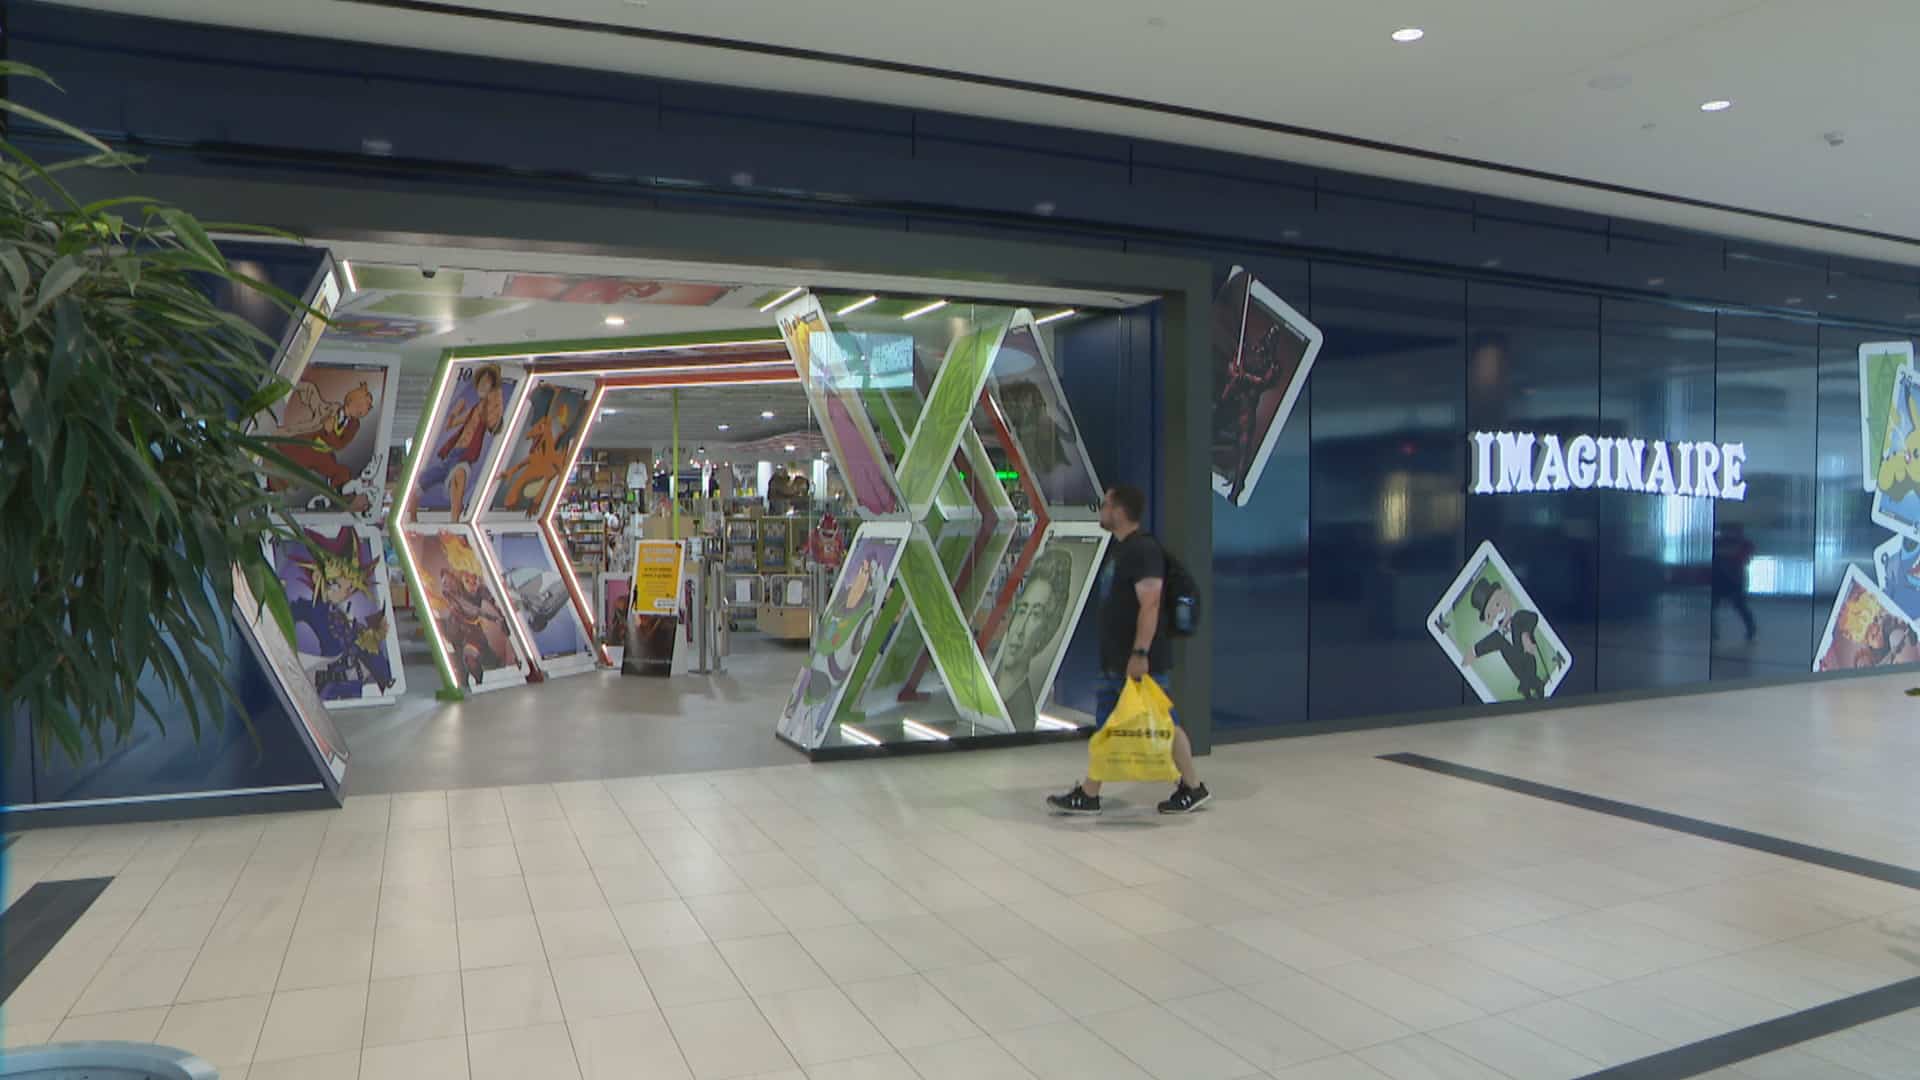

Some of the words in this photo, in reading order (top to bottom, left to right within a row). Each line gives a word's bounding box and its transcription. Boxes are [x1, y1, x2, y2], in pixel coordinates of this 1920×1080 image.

[458, 367, 473, 382] 10
[1473, 430, 1747, 501] IMAGINAIRE
[1434, 611, 1451, 635] K
